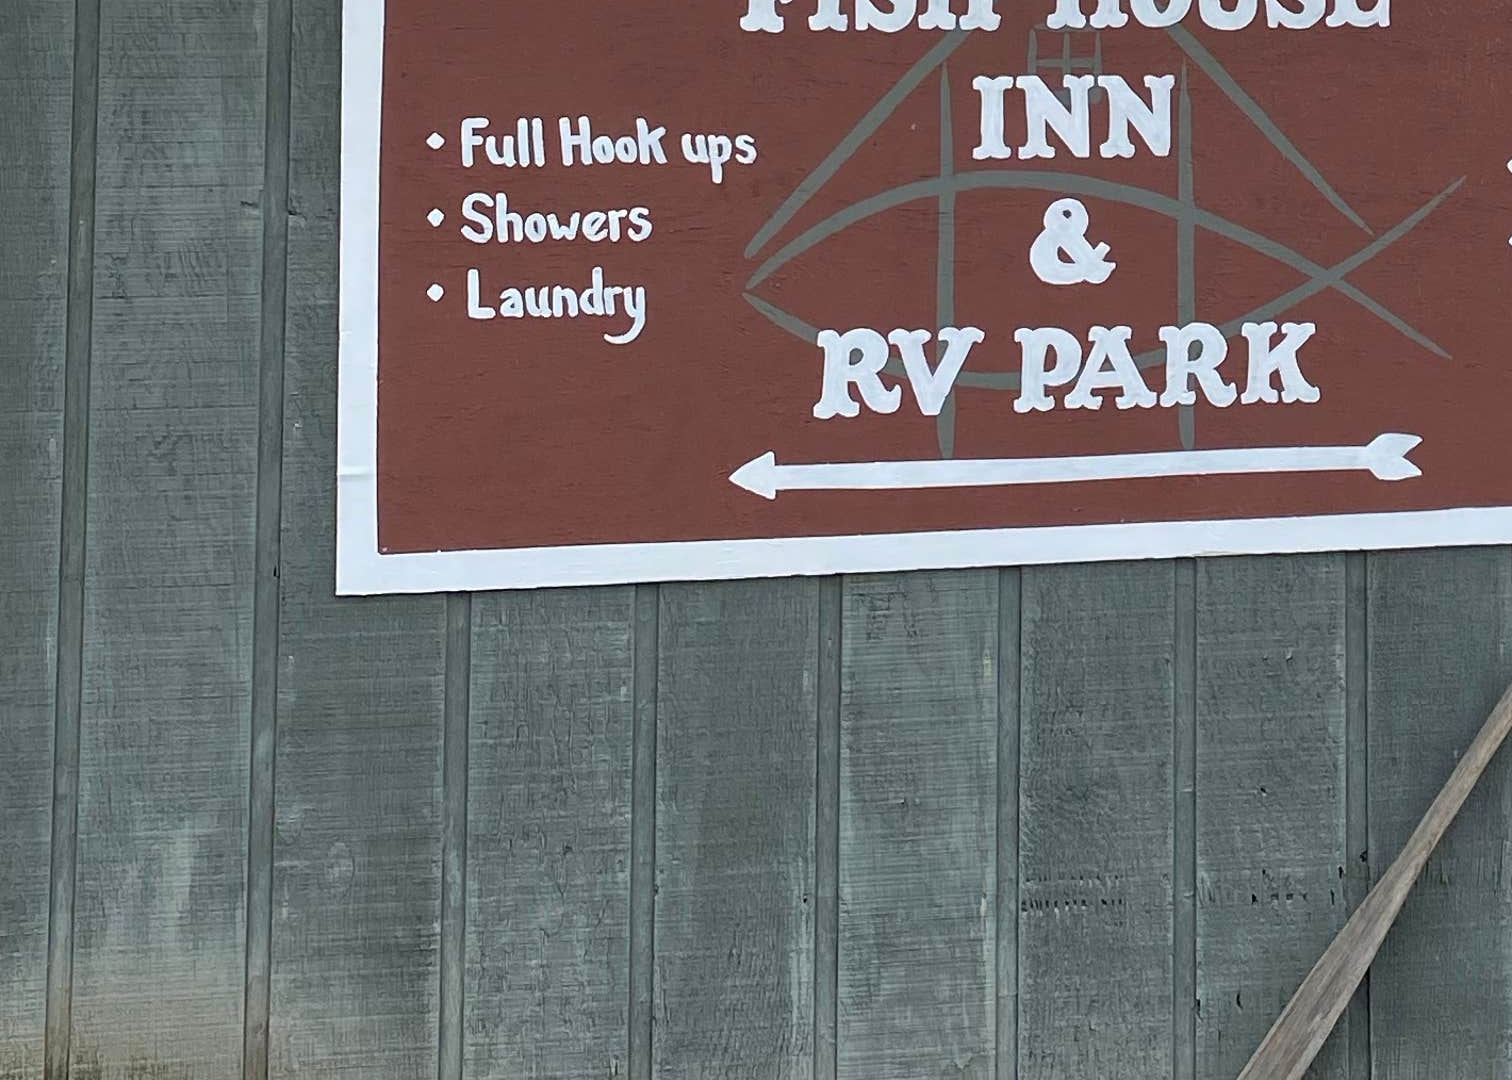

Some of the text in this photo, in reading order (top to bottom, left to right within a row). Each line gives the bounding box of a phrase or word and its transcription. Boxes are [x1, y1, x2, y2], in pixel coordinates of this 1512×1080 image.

[460, 115, 757, 184] Full Hook ups
[972, 73, 1175, 160] INN
[460, 192, 653, 244] Showers
[1029, 197, 1117, 285] &
[467, 266, 646, 345] Laundry
[813, 321, 1321, 420] RV PARK
